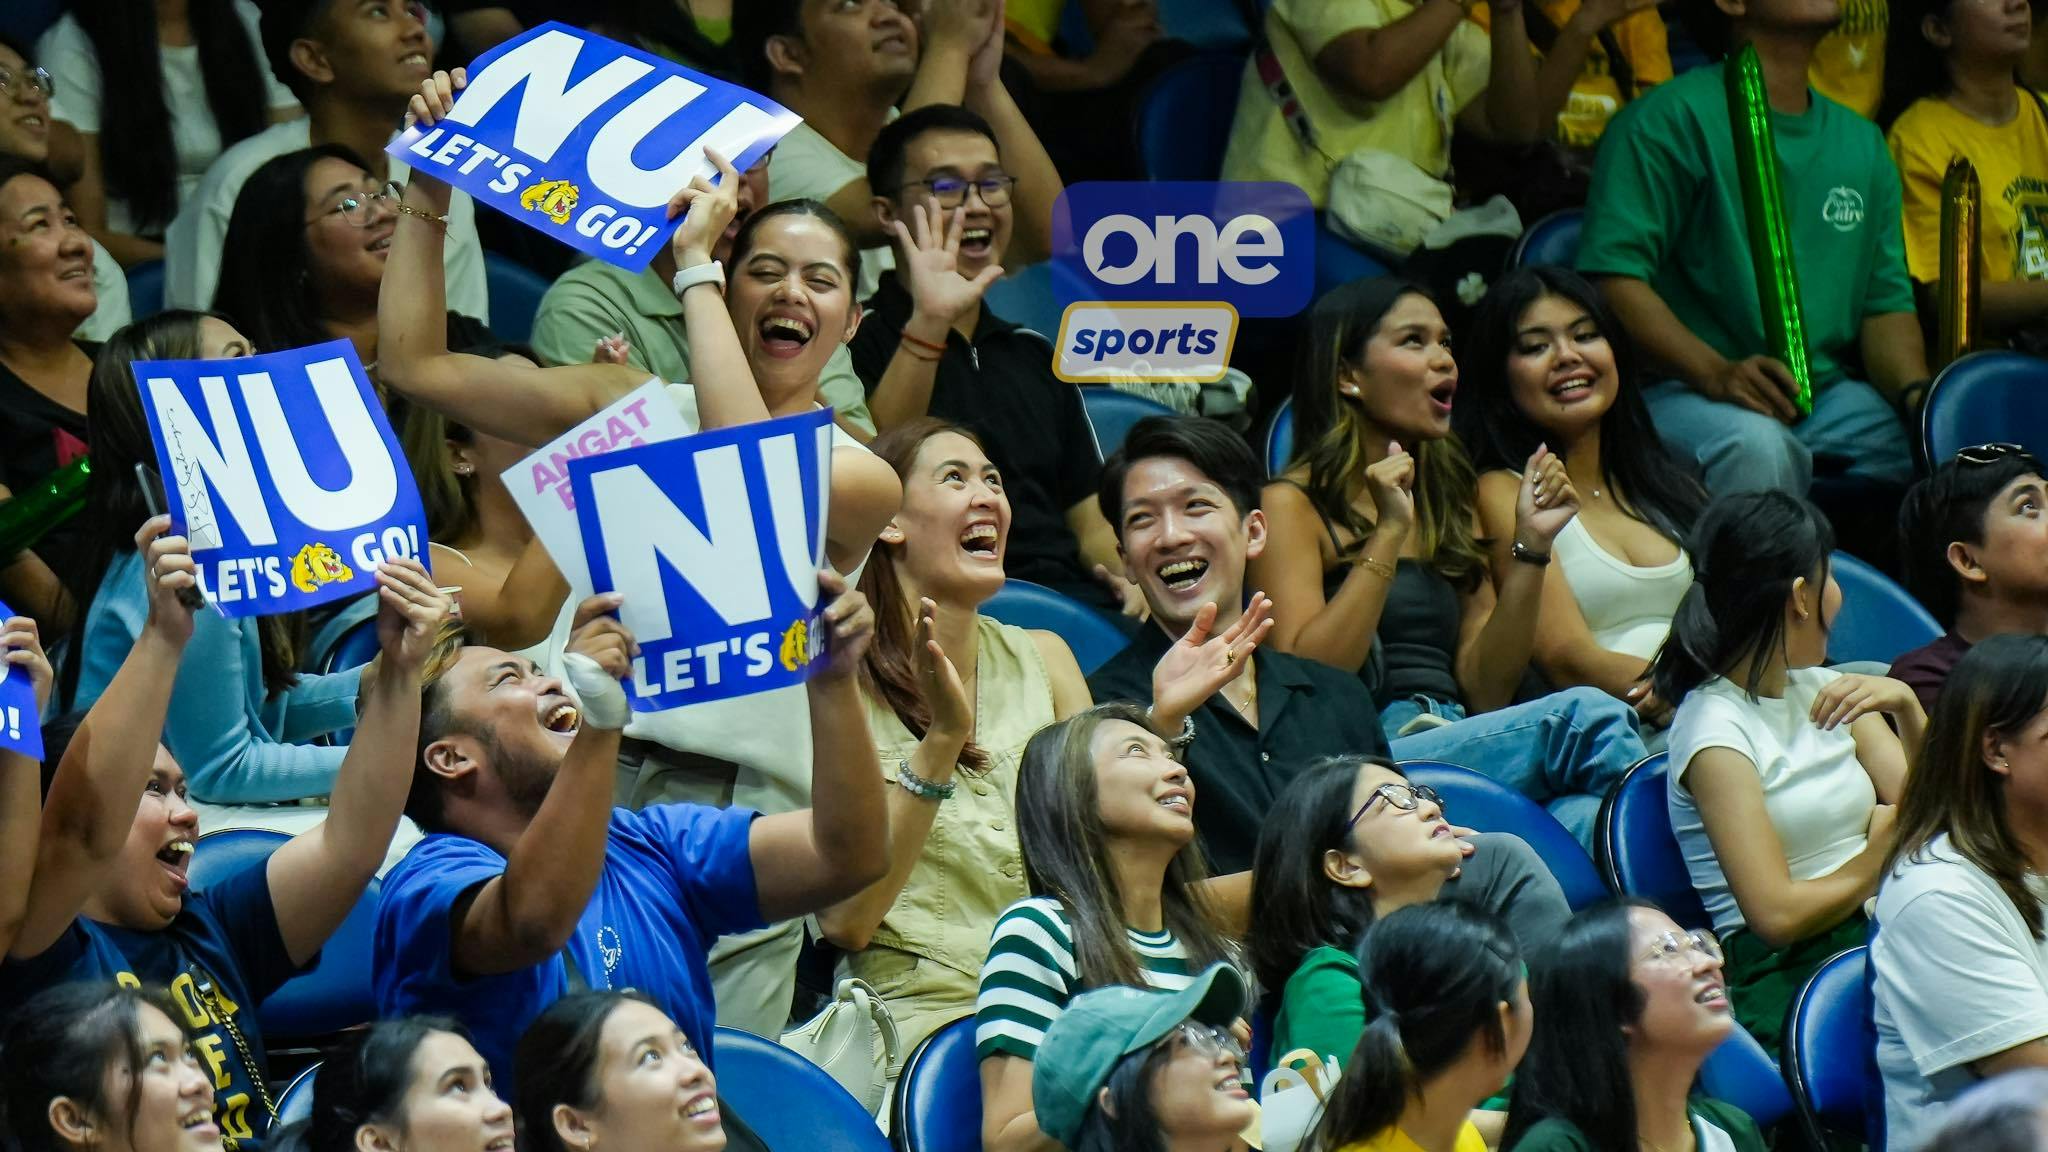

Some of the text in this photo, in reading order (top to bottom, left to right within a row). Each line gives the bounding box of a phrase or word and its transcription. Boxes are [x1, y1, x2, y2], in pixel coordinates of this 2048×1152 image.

[444, 29, 782, 208] NU
[409, 128, 659, 256] LET'S GO!
[147, 357, 398, 551] NU
[532, 398, 650, 495] ANGAT
[196, 525, 420, 603] LET'S GO!
[591, 423, 833, 644] NU
[632, 632, 773, 698] LET'S
